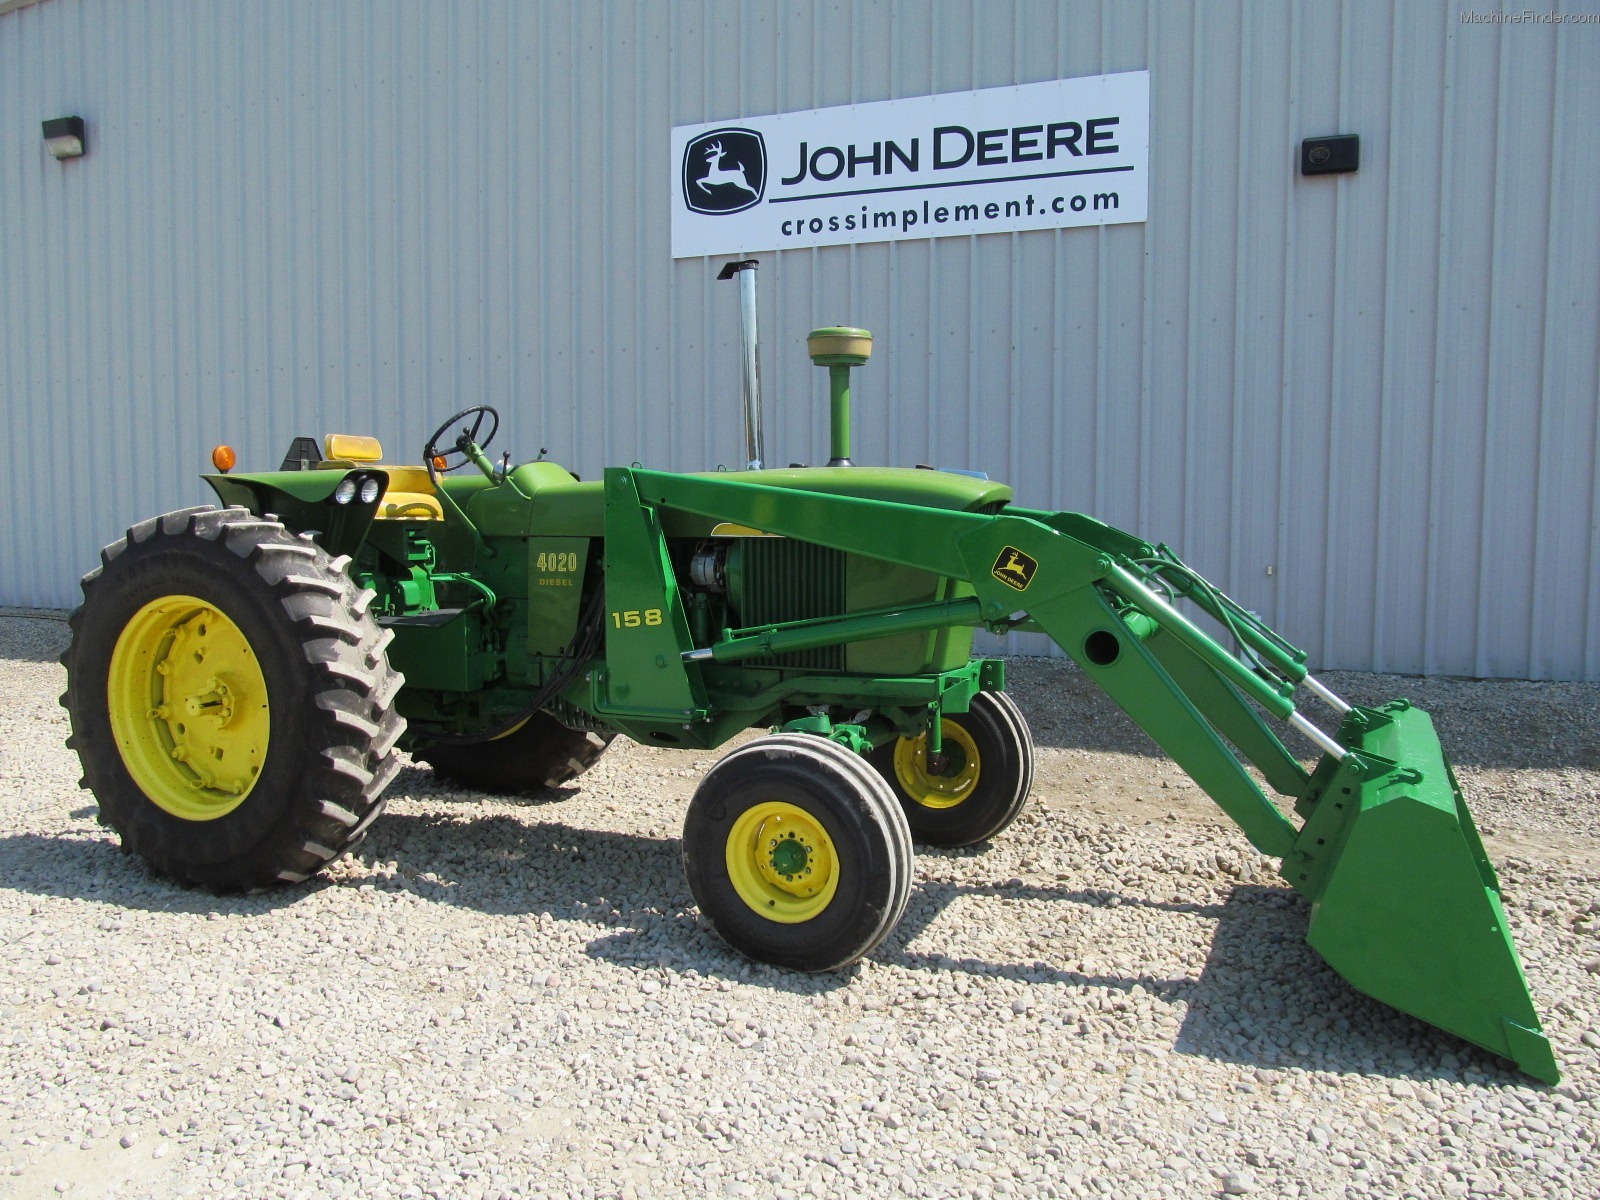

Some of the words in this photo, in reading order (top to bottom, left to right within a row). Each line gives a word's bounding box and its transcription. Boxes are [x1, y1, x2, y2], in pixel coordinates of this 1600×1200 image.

[781, 137, 919, 186] JOHN
[933, 116, 1120, 171] DEERE
[781, 192, 1120, 236] crossimplement.com
[536, 552, 577, 572] 4020
[539, 578, 574, 586] DIESEL
[994, 570, 1007, 579] JOHN
[1007, 577, 1023, 588] DEERE
[612, 608, 663, 629] 158
